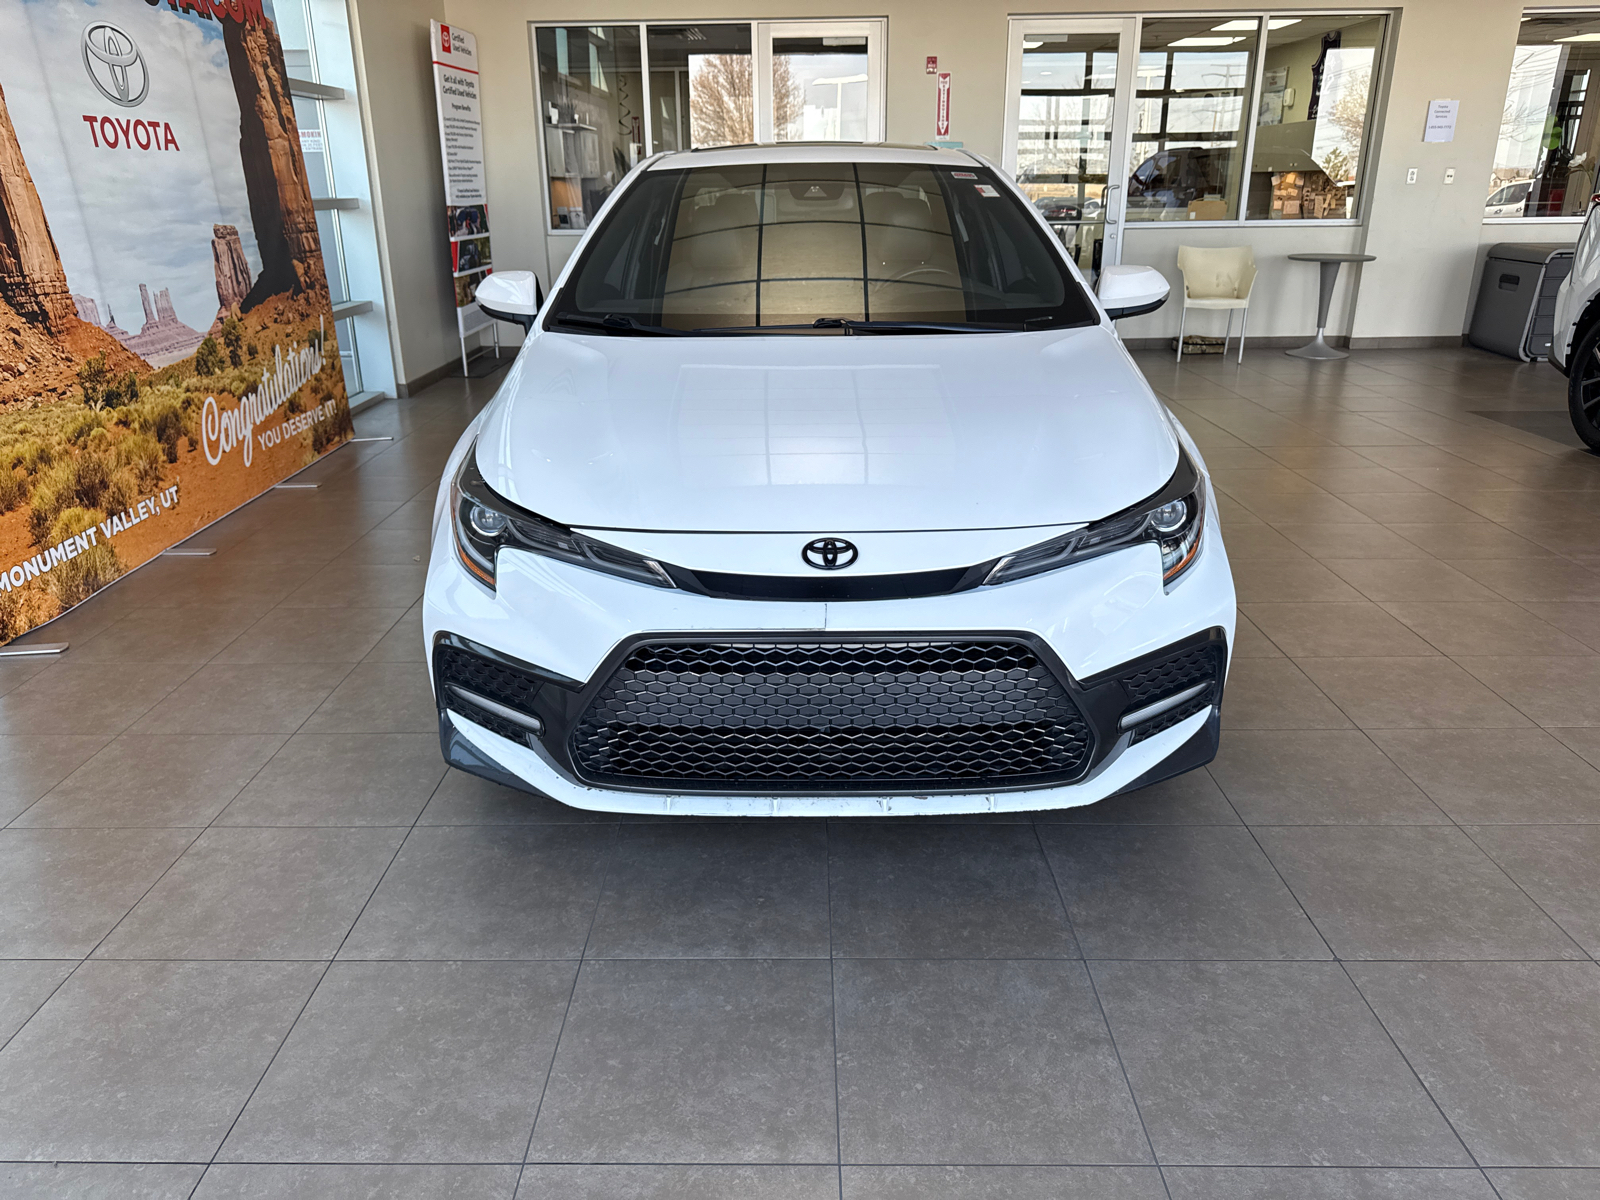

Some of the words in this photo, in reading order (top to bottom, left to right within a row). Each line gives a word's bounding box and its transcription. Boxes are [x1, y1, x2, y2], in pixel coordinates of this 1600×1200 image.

[82, 115, 180, 151] TOYOTA
[202, 314, 326, 467] Congratulations!
[257, 426, 281, 451] YOU
[282, 405, 325, 439] DESERVE
[324, 399, 338, 417] IT!
[0, 526, 97, 597] MONUMENT
[99, 496, 161, 539] VALLEY,
[159, 485, 178, 508] UT
